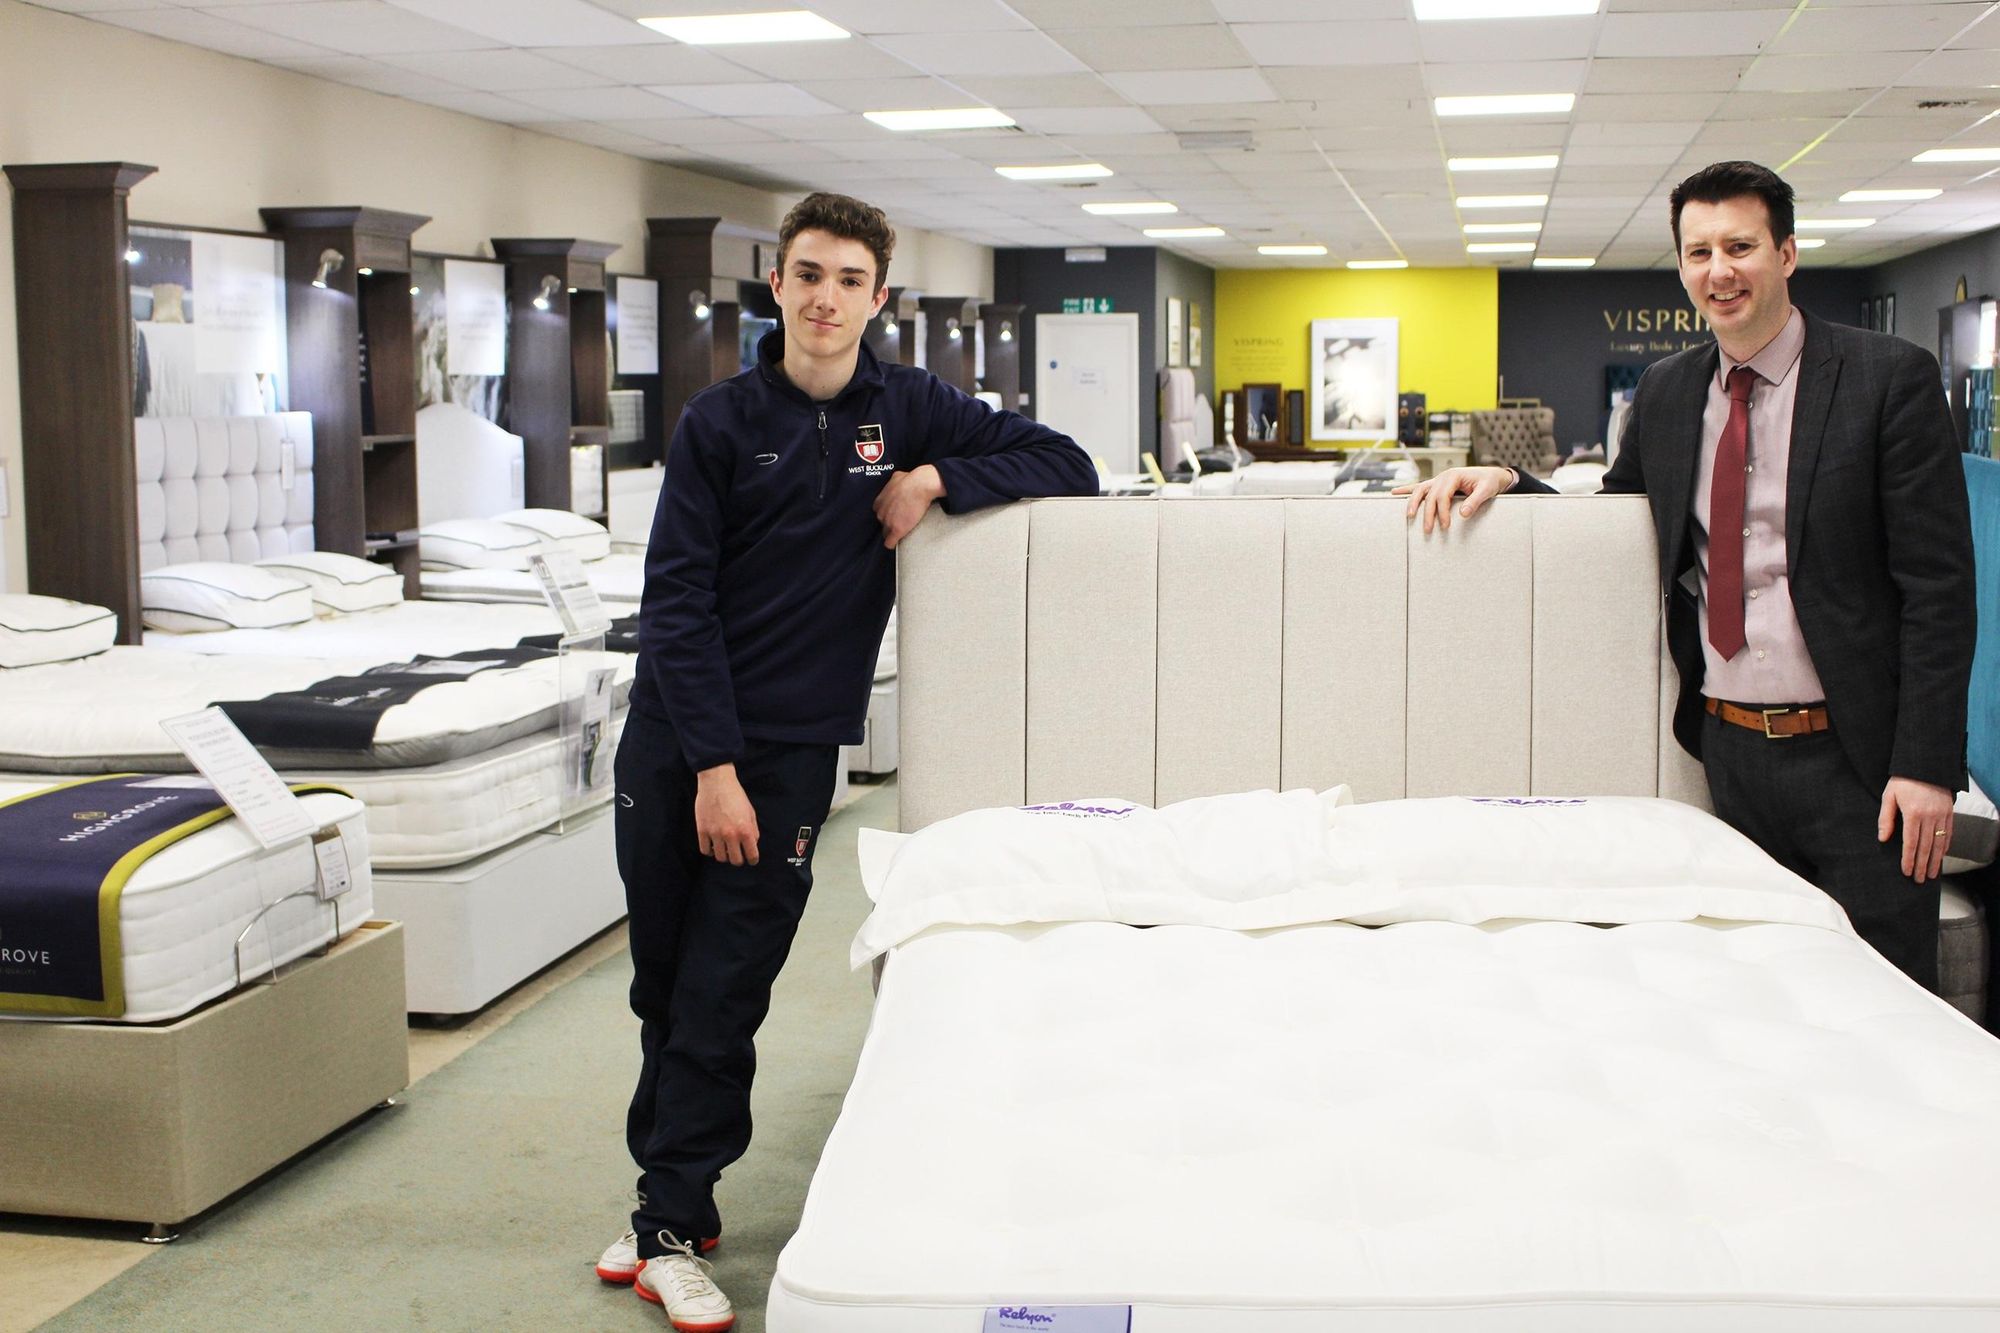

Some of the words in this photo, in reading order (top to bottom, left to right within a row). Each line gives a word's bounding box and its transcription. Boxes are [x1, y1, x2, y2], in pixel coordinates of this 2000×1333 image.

[1603, 308, 1710, 333] VISPRI
[848, 466, 865, 474] WEST
[865, 463, 895, 472] BUCKLAND
[1, 948, 51, 965] ROVE
[999, 1306, 1053, 1325] Relyon
